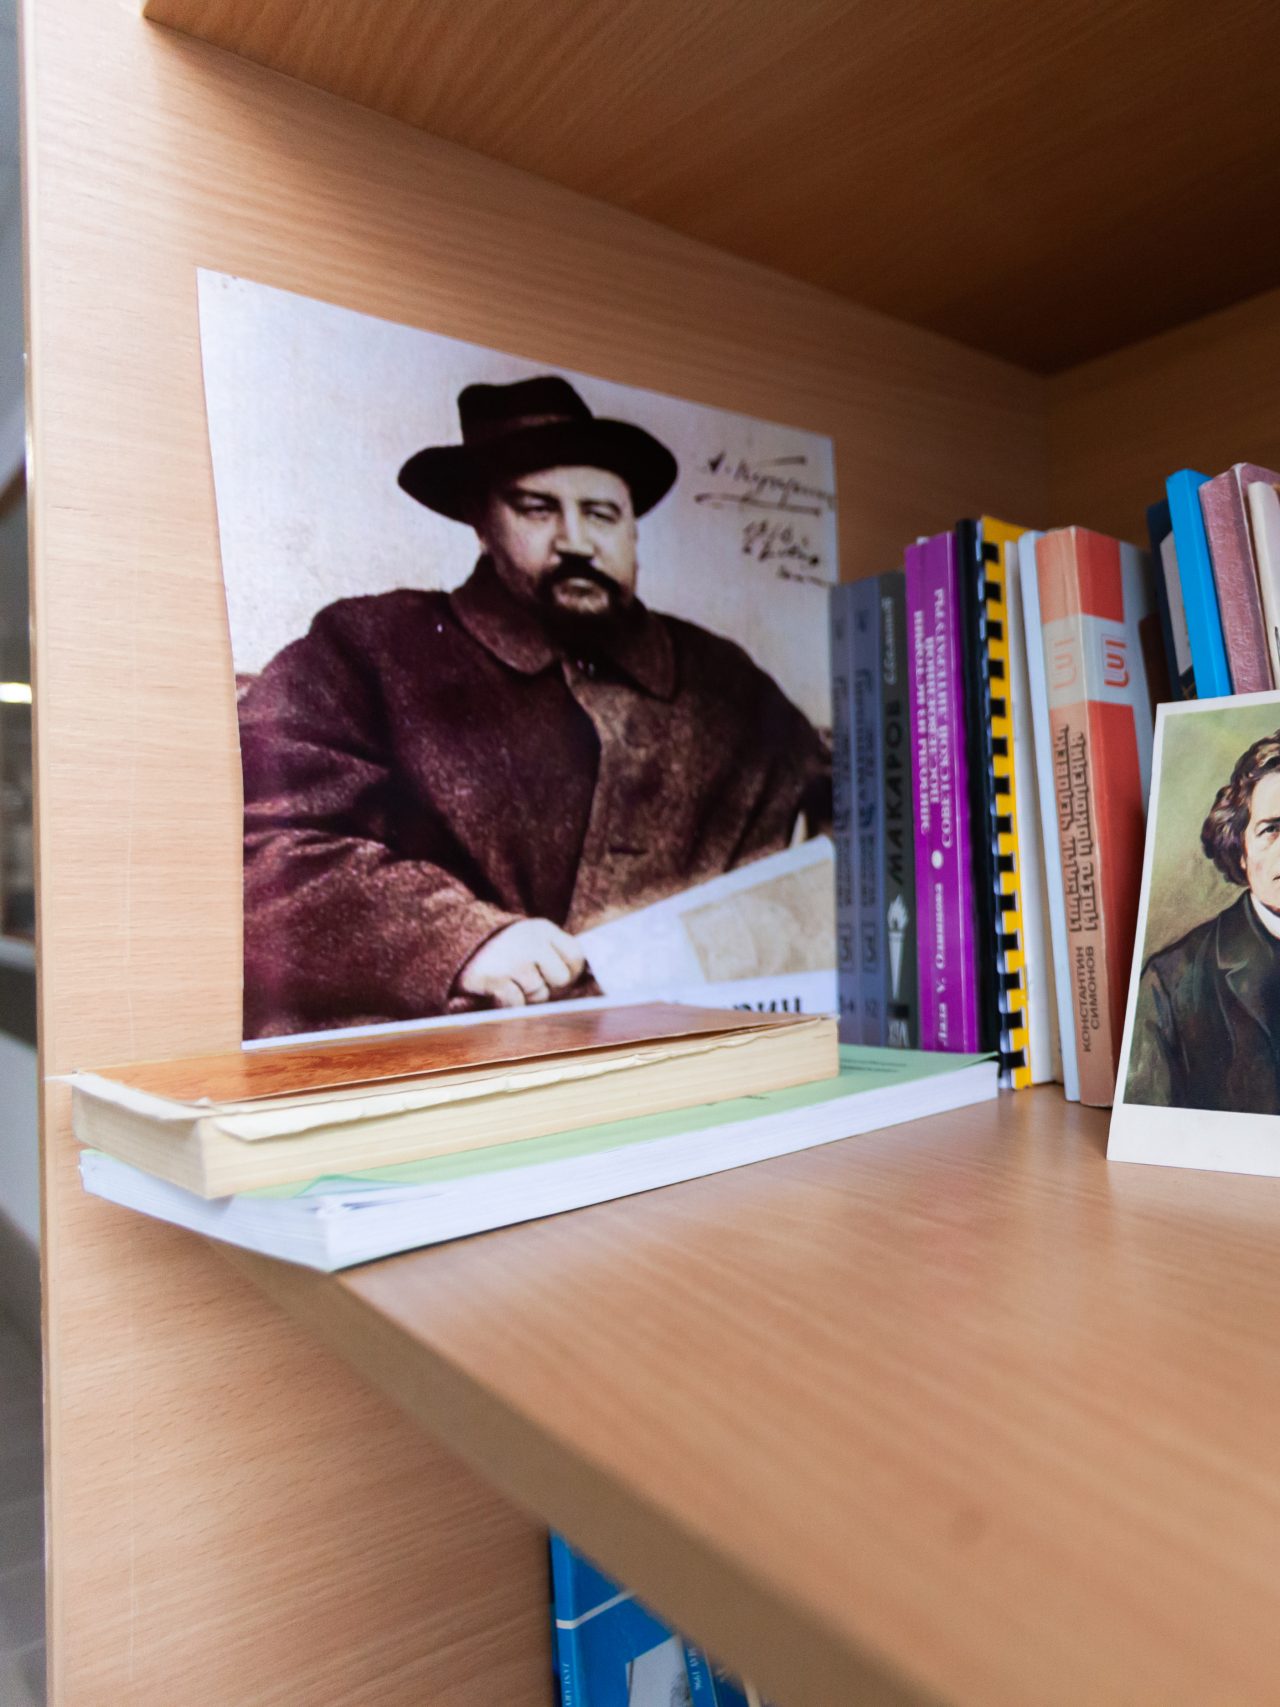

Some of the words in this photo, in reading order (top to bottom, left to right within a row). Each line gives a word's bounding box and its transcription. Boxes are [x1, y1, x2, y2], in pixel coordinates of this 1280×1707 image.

[913, 610, 926, 705] ИСТОРИИ
[933, 588, 949, 721] ЛИТЕРАТУРЫ
[917, 708, 927, 734] ИЗ
[886, 701, 906, 886] МАКАРОВ
[918, 738, 931, 836] ЭПИЗОДЫ
[938, 725, 954, 848] СОВЕТСКОЙ
[1054, 723, 1074, 830] ЧЕЛОВЕКА
[1069, 732, 1094, 856] ПОКОЛЕНИЯ
[934, 882, 946, 970] Одинцова
[1061, 837, 1082, 933] ГЛАЗАМИ
[1081, 860, 1098, 931] МОЕГО
[1075, 945, 1091, 1053] КОНСТАНТИН
[1085, 945, 1100, 1031] СИМОНОВ
